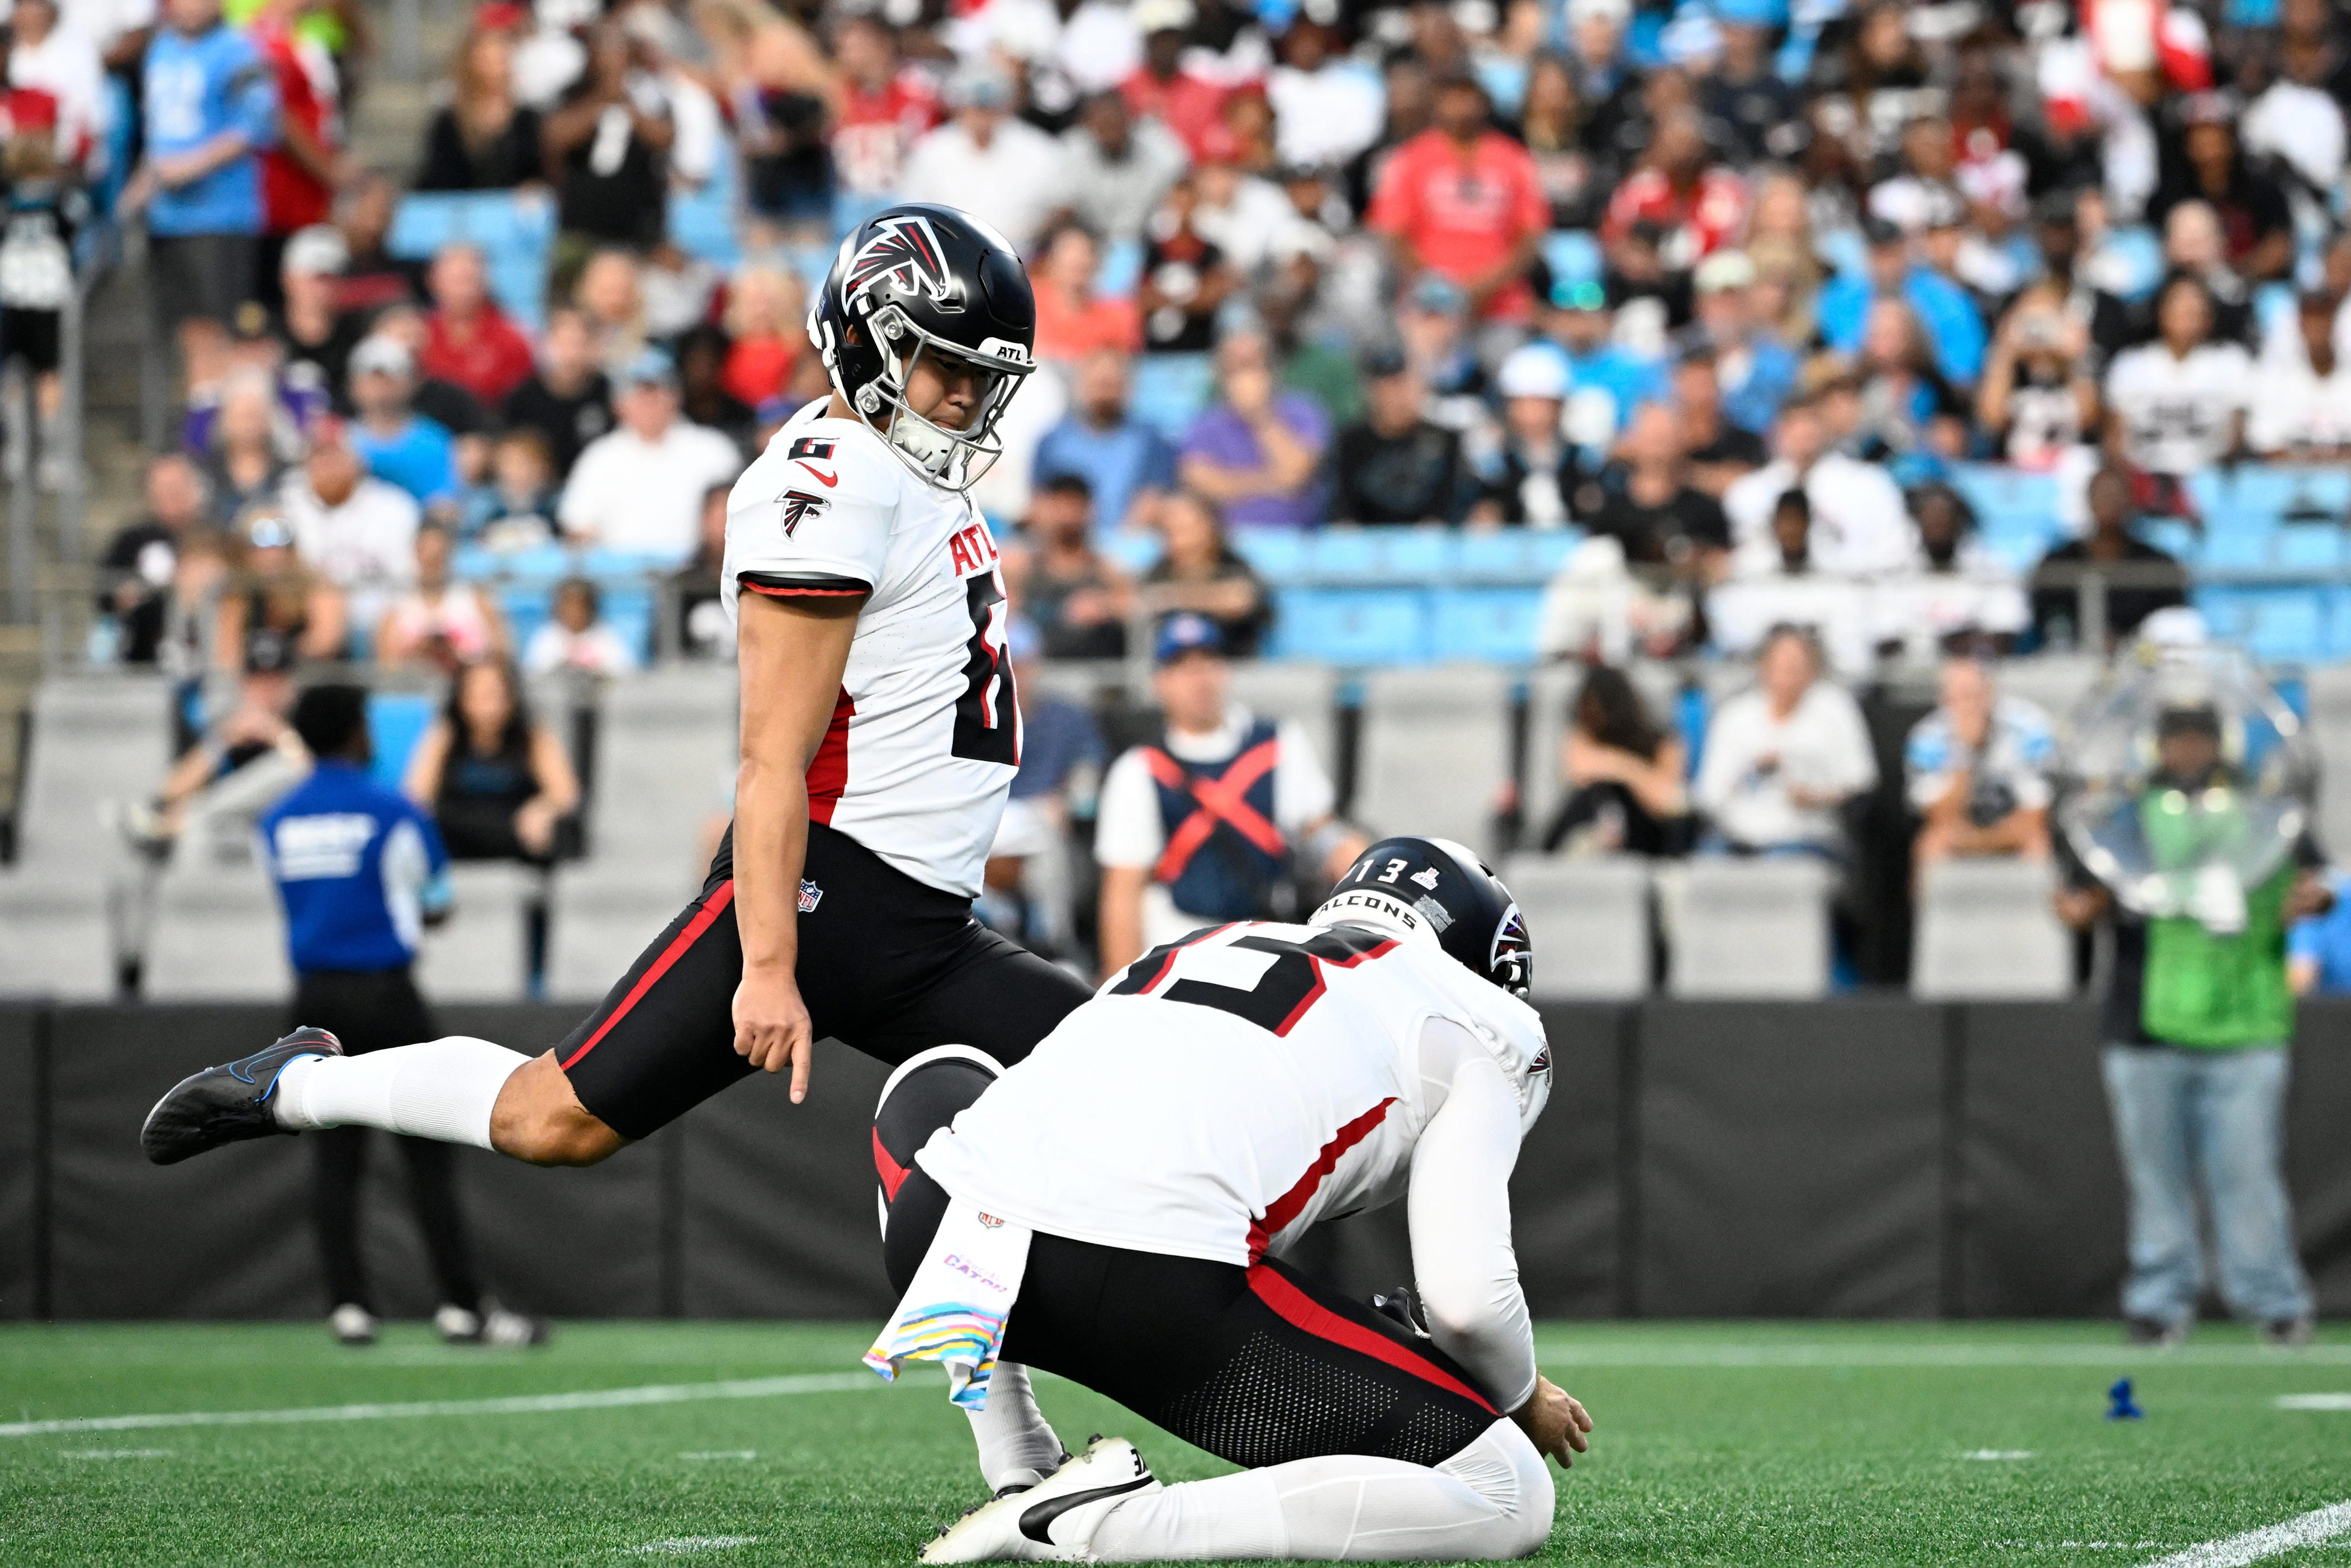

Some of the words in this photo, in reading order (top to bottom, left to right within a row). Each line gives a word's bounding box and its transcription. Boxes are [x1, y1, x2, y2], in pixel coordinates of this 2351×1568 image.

[996, 346, 1021, 361] ATL
[787, 437, 840, 460] 6
[950, 523, 998, 577] ATL
[1354, 858, 1409, 884] 13
